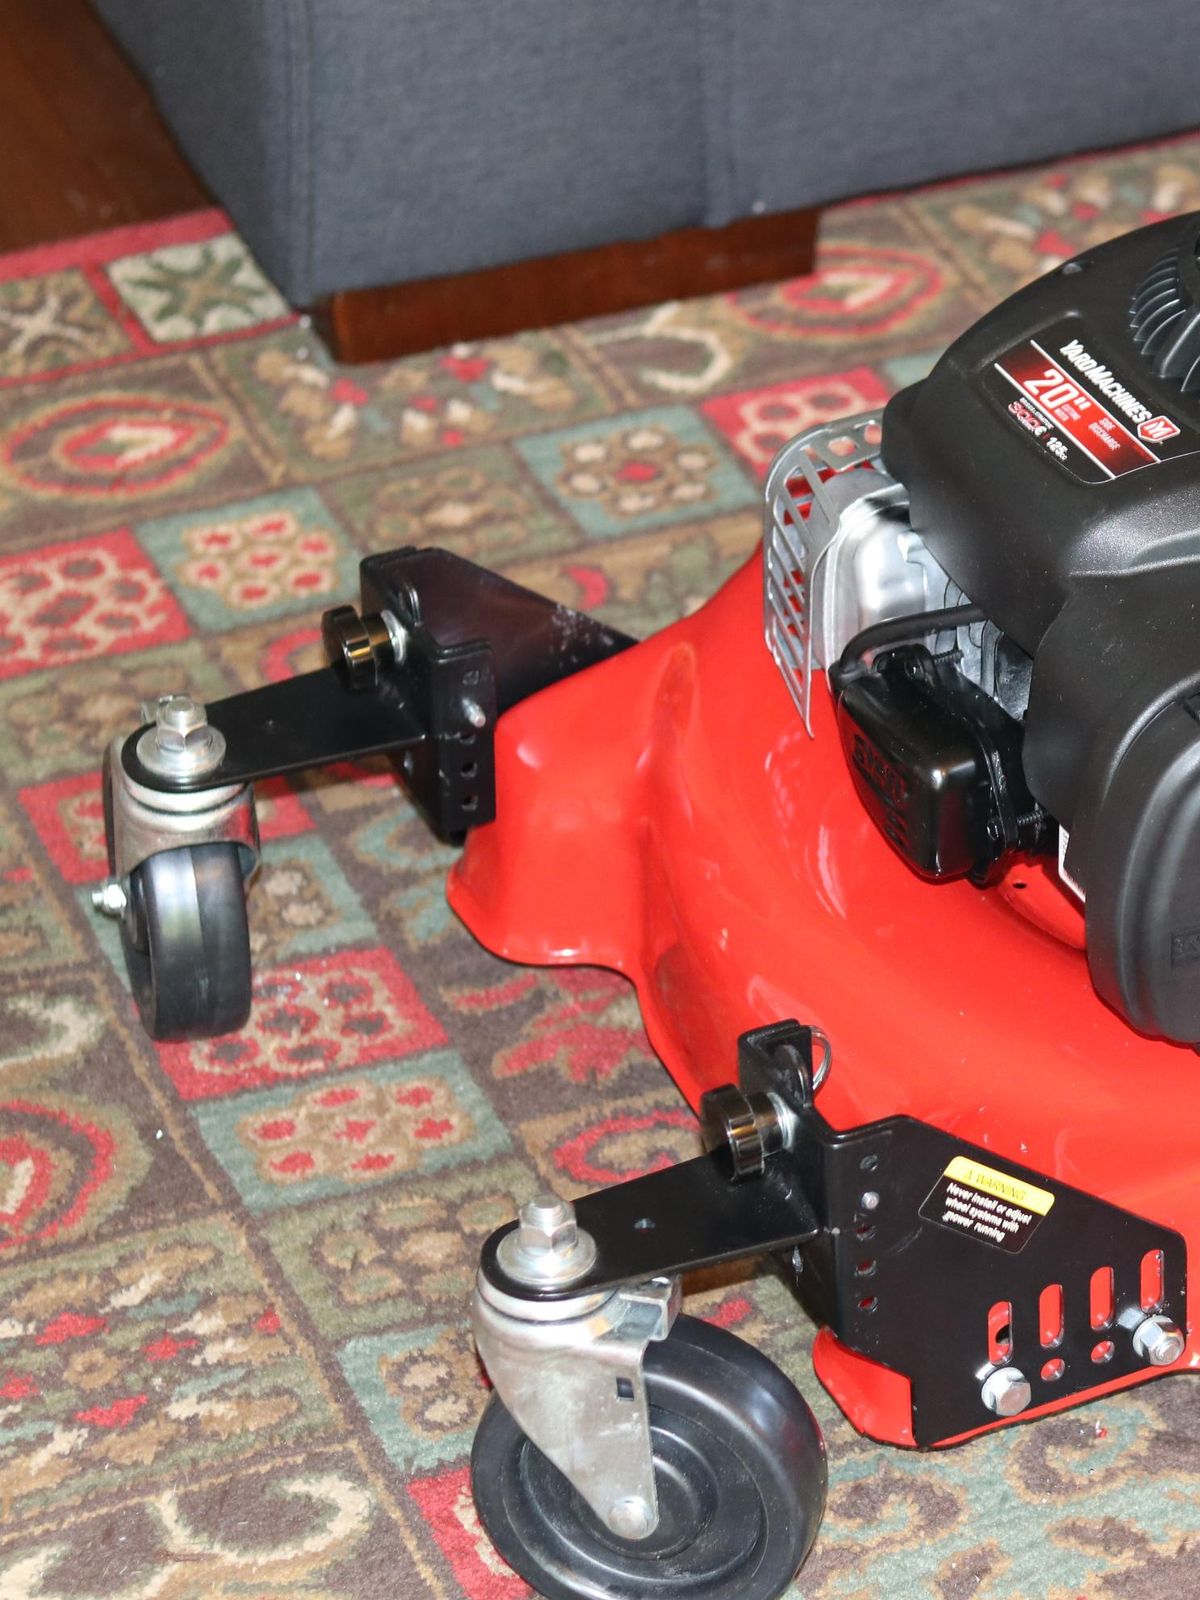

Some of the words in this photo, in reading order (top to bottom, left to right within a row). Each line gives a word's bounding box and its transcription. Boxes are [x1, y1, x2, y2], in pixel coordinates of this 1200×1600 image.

[1023, 369, 1092, 411] 20"
[1088, 422, 1121, 451] DISCHARGE
[1099, 418, 1116, 431] SIDE
[976, 1174, 1026, 1200] WARNING
[945, 1197, 971, 1213] wheel
[969, 1206, 1002, 1227] systems
[1001, 1219, 1020, 1234] with
[946, 1182, 974, 1200] Never
[971, 1192, 998, 1211] install
[996, 1204, 1007, 1215] or
[1005, 1208, 1032, 1226] adjust
[973, 1222, 1006, 1243] running
